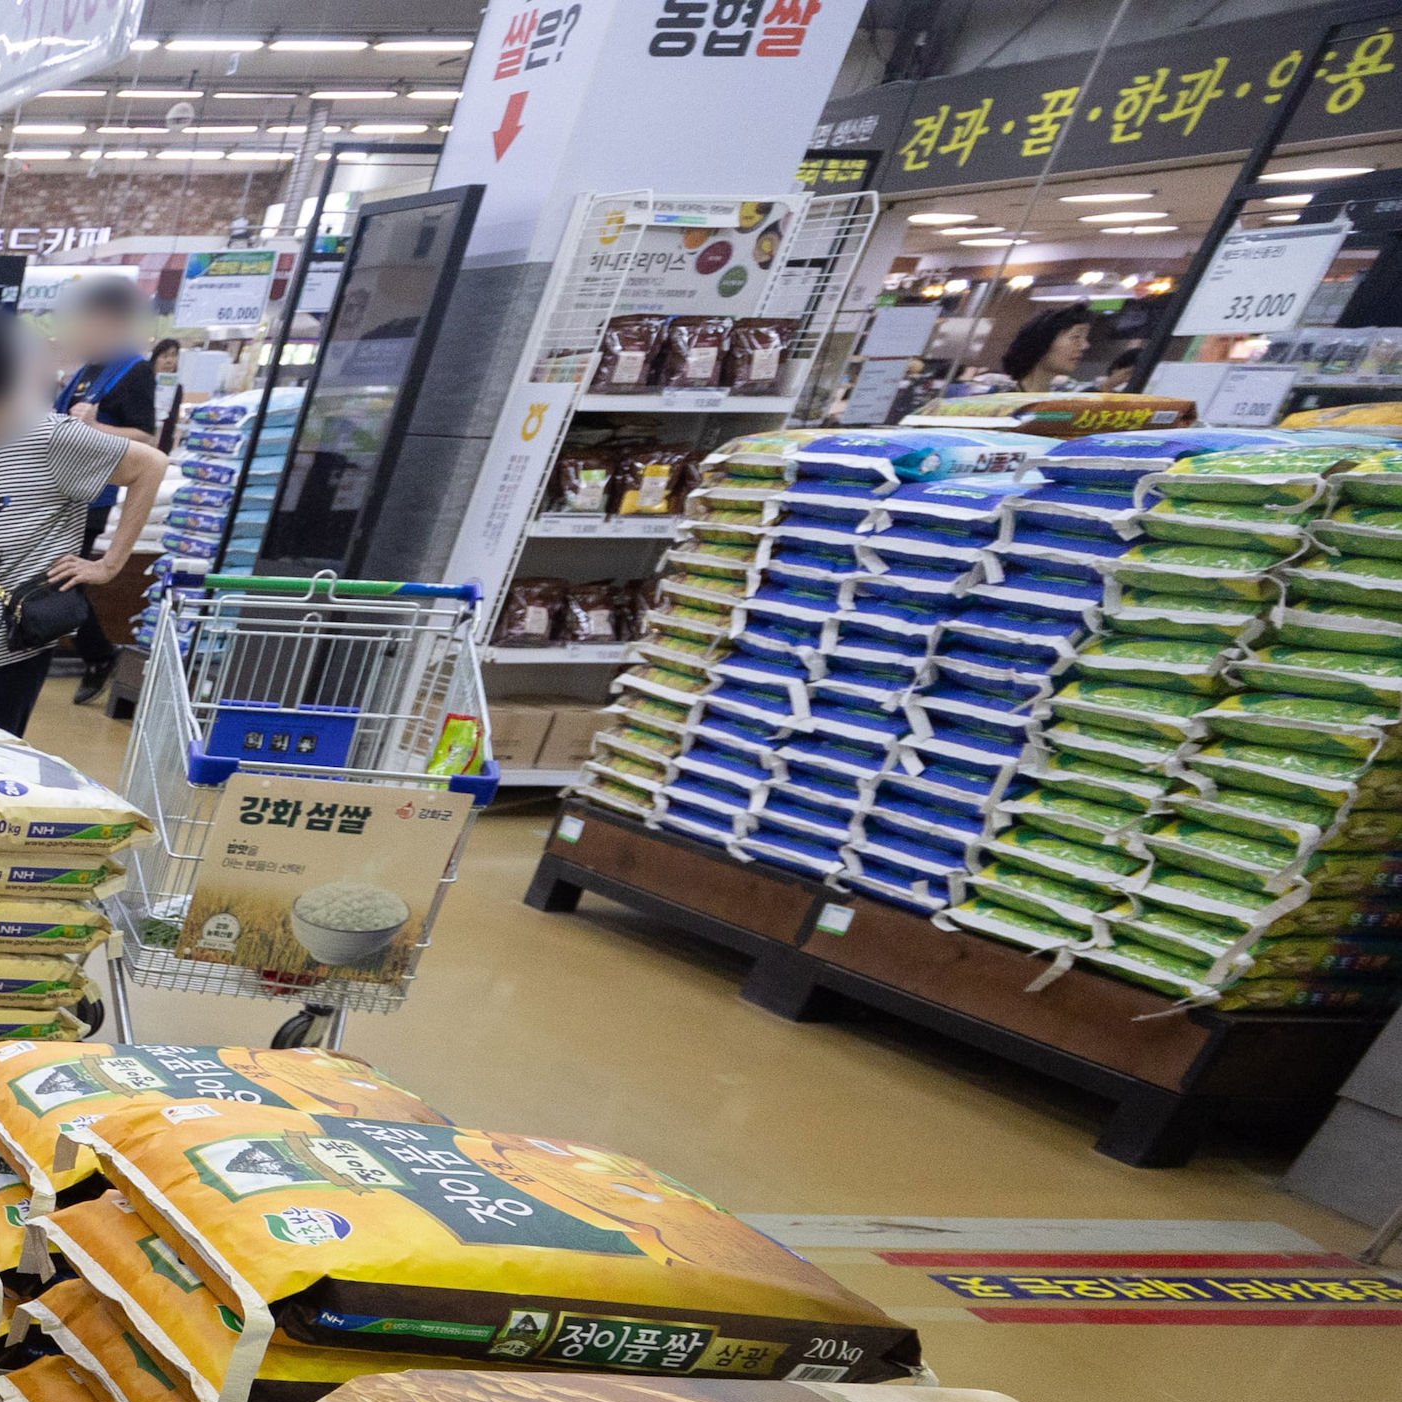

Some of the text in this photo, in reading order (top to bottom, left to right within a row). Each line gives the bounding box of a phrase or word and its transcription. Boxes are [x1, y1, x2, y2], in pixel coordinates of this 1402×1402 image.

[1224, 293, 1296, 321] 33,000
[240, 795, 373, 835] 강화섬쌀
[418, 808, 453, 822] 강화군
[31, 826, 55, 836] NH
[227, 842, 259, 857] 밥맛을
[12, 870, 35, 880] NH
[315, 1138, 388, 1186] 정이품
[345, 1119, 534, 1228] 정이품쌀
[948, 1276, 1012, 1299] 곳
[1009, 1277, 1212, 1300] 내려오는
[319, 1310, 346, 1328] NH
